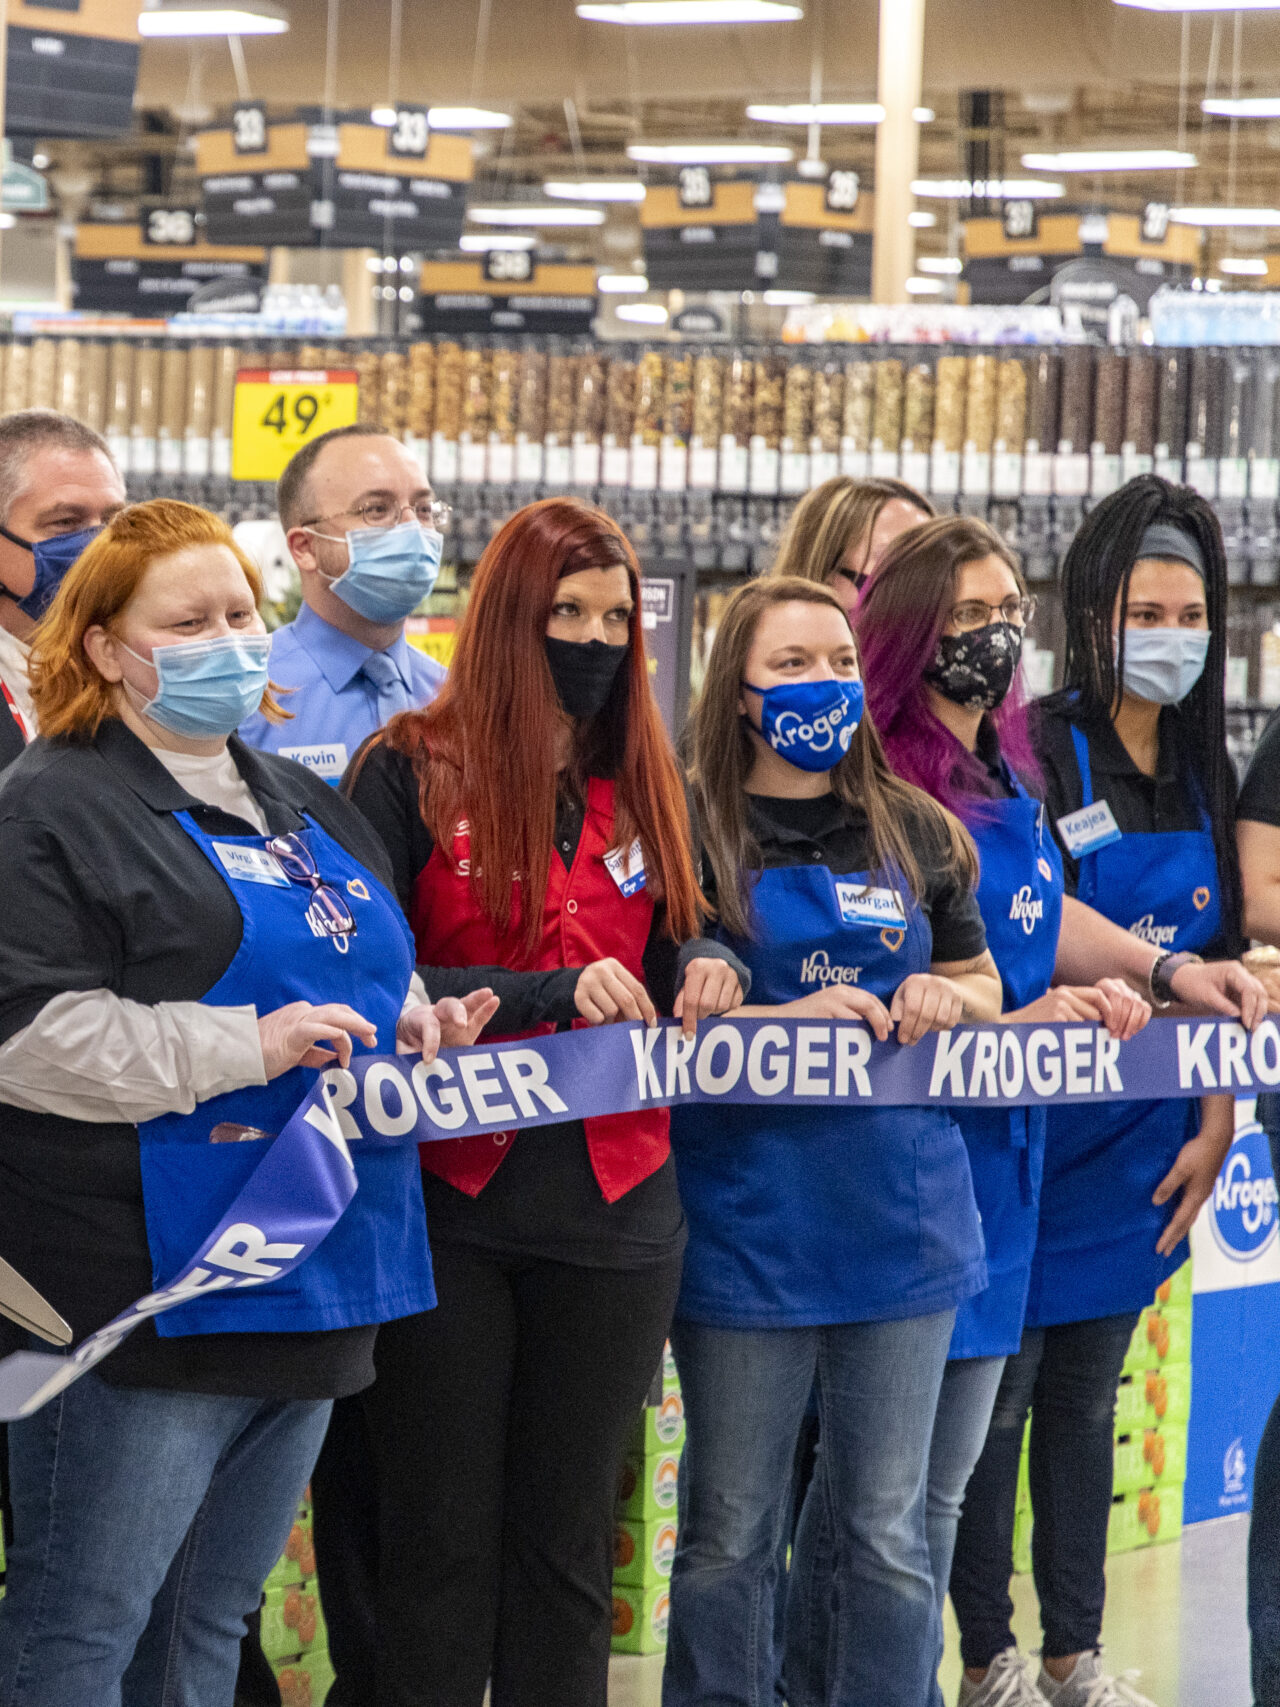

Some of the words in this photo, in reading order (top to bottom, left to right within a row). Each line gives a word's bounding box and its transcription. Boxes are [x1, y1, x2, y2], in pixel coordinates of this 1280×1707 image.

[769, 699, 849, 752] Kroger
[1065, 809, 1107, 835] Keajea
[227, 850, 270, 866] Virgiia
[800, 950, 863, 989] Kroger
[629, 1024, 872, 1100] KROGER
[928, 1027, 1124, 1099] KROGER
